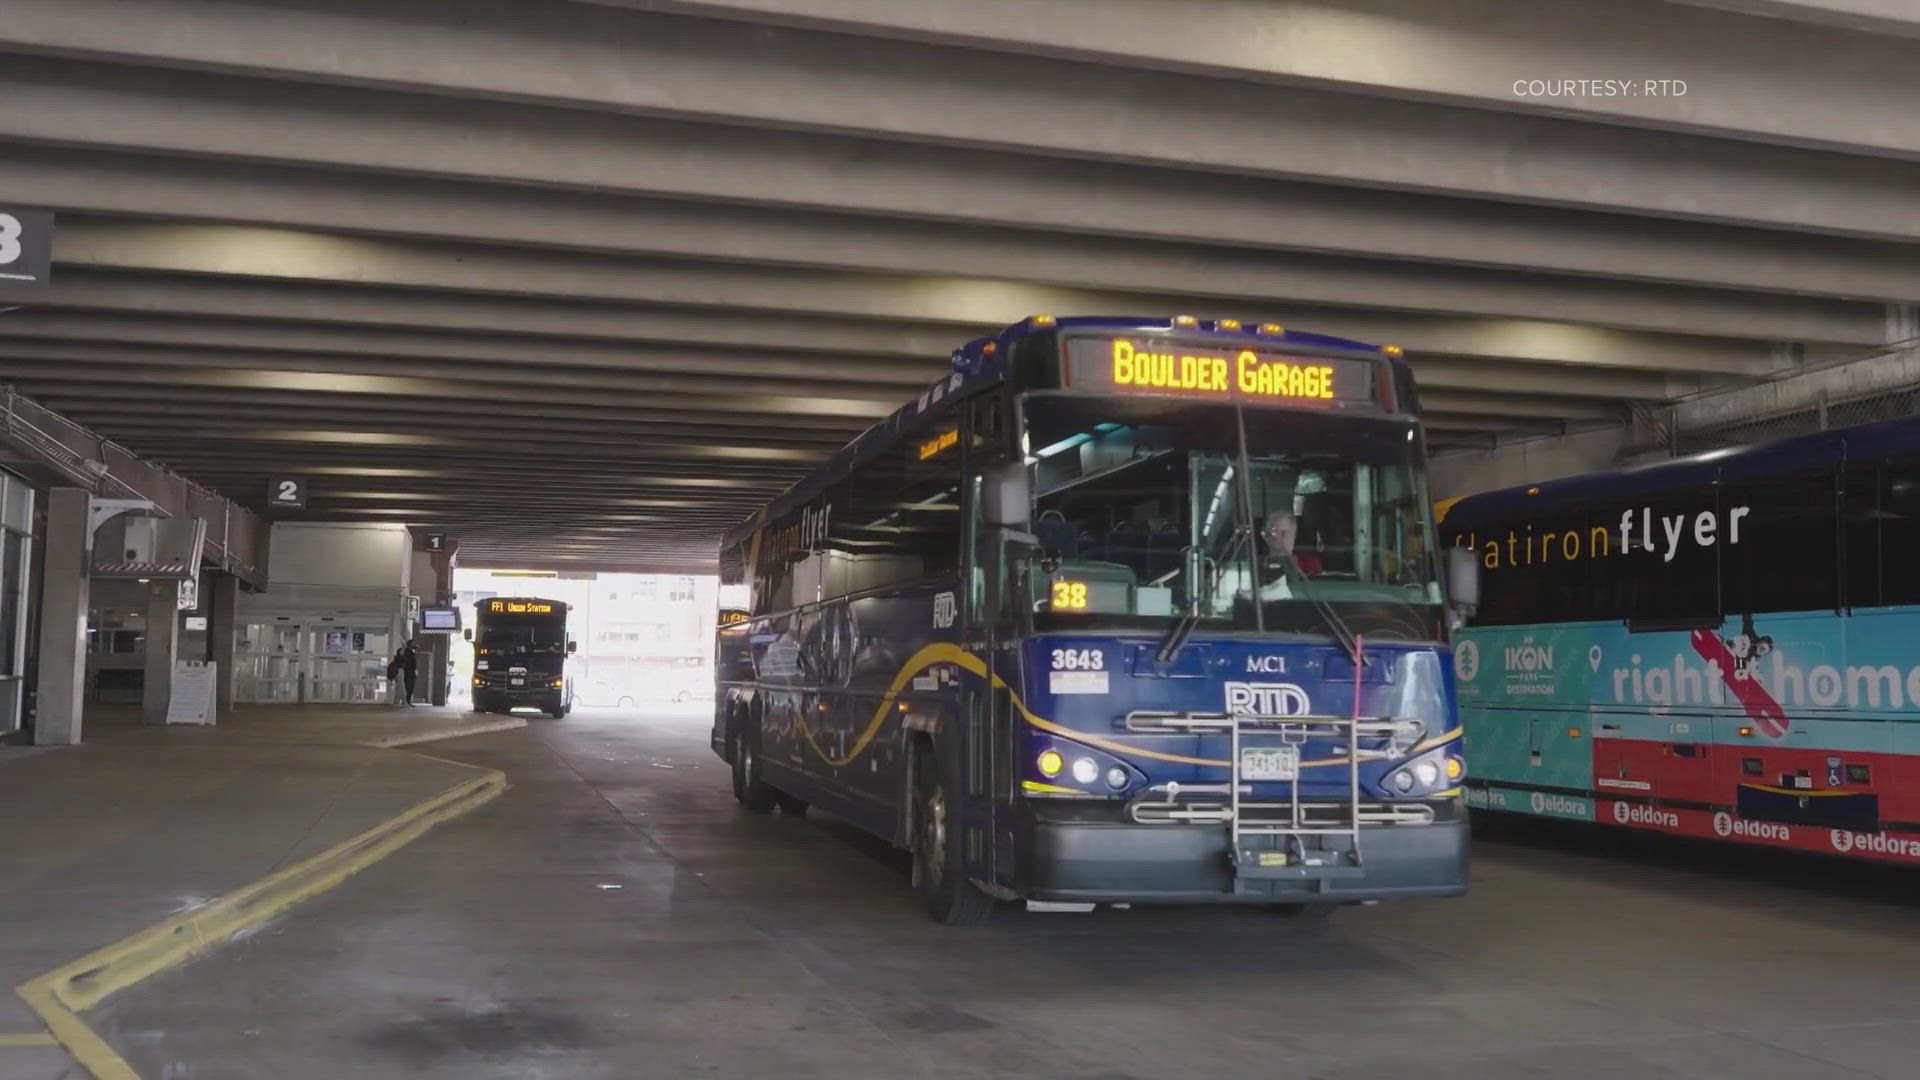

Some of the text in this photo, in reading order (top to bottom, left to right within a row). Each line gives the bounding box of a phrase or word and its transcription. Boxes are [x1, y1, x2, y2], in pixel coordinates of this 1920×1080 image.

[1113, 341, 1334, 398] BOULDER GARAGE
[278, 480, 297, 500] 2
[431, 537, 439, 548] 1
[1619, 506, 1750, 562] flyer
[1052, 582, 1087, 609] 38
[1051, 649, 1104, 670] 3643
[1246, 655, 1286, 673] MCI
[1505, 646, 1553, 671] IKON
[1613, 654, 1725, 715] right
[1224, 681, 1311, 716] RTD
[1545, 799, 1586, 815] eldora
[1630, 806, 1679, 827] eldora
[1733, 819, 1790, 841] eldora
[1854, 832, 1920, 857] eldora
